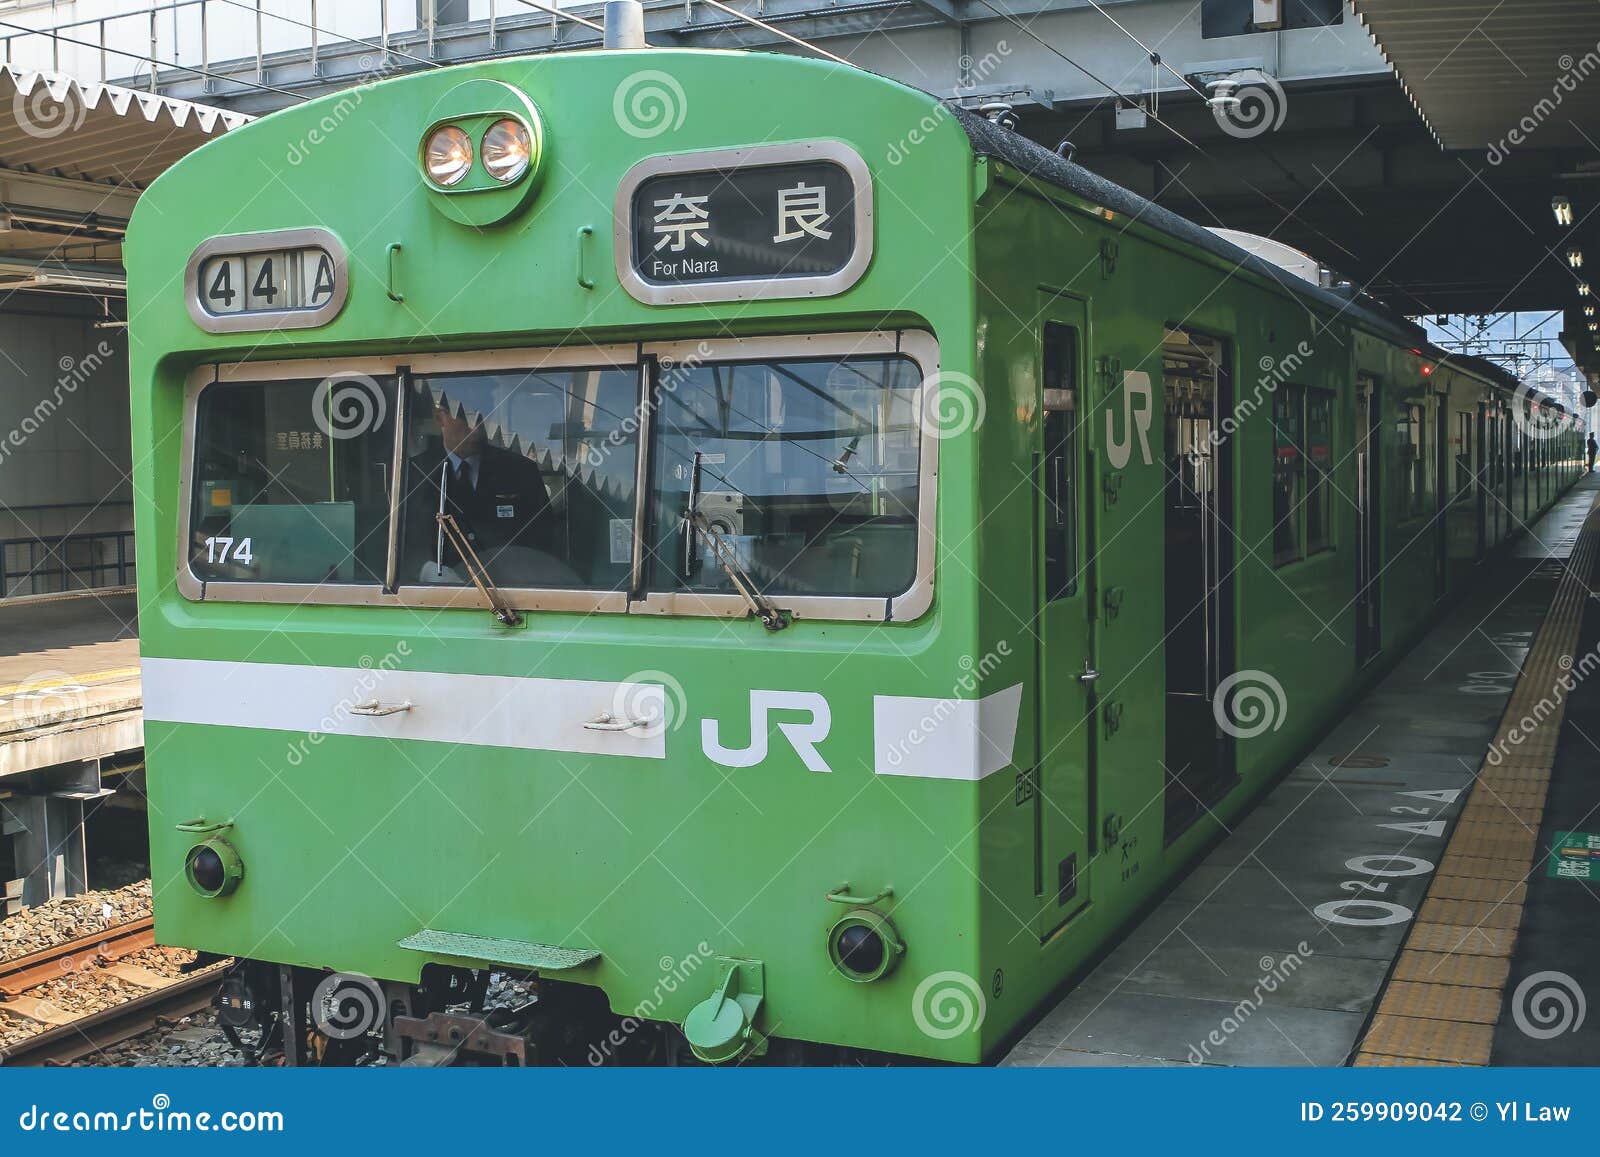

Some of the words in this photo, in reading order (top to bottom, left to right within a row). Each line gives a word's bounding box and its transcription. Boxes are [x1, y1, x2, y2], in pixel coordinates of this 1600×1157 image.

[653, 182, 833, 252] 奈良
[653, 261, 678, 276] For
[682, 258, 719, 274] Nara
[1106, 370, 1153, 470] JR
[205, 537, 253, 565] 174
[701, 689, 832, 773] JR
